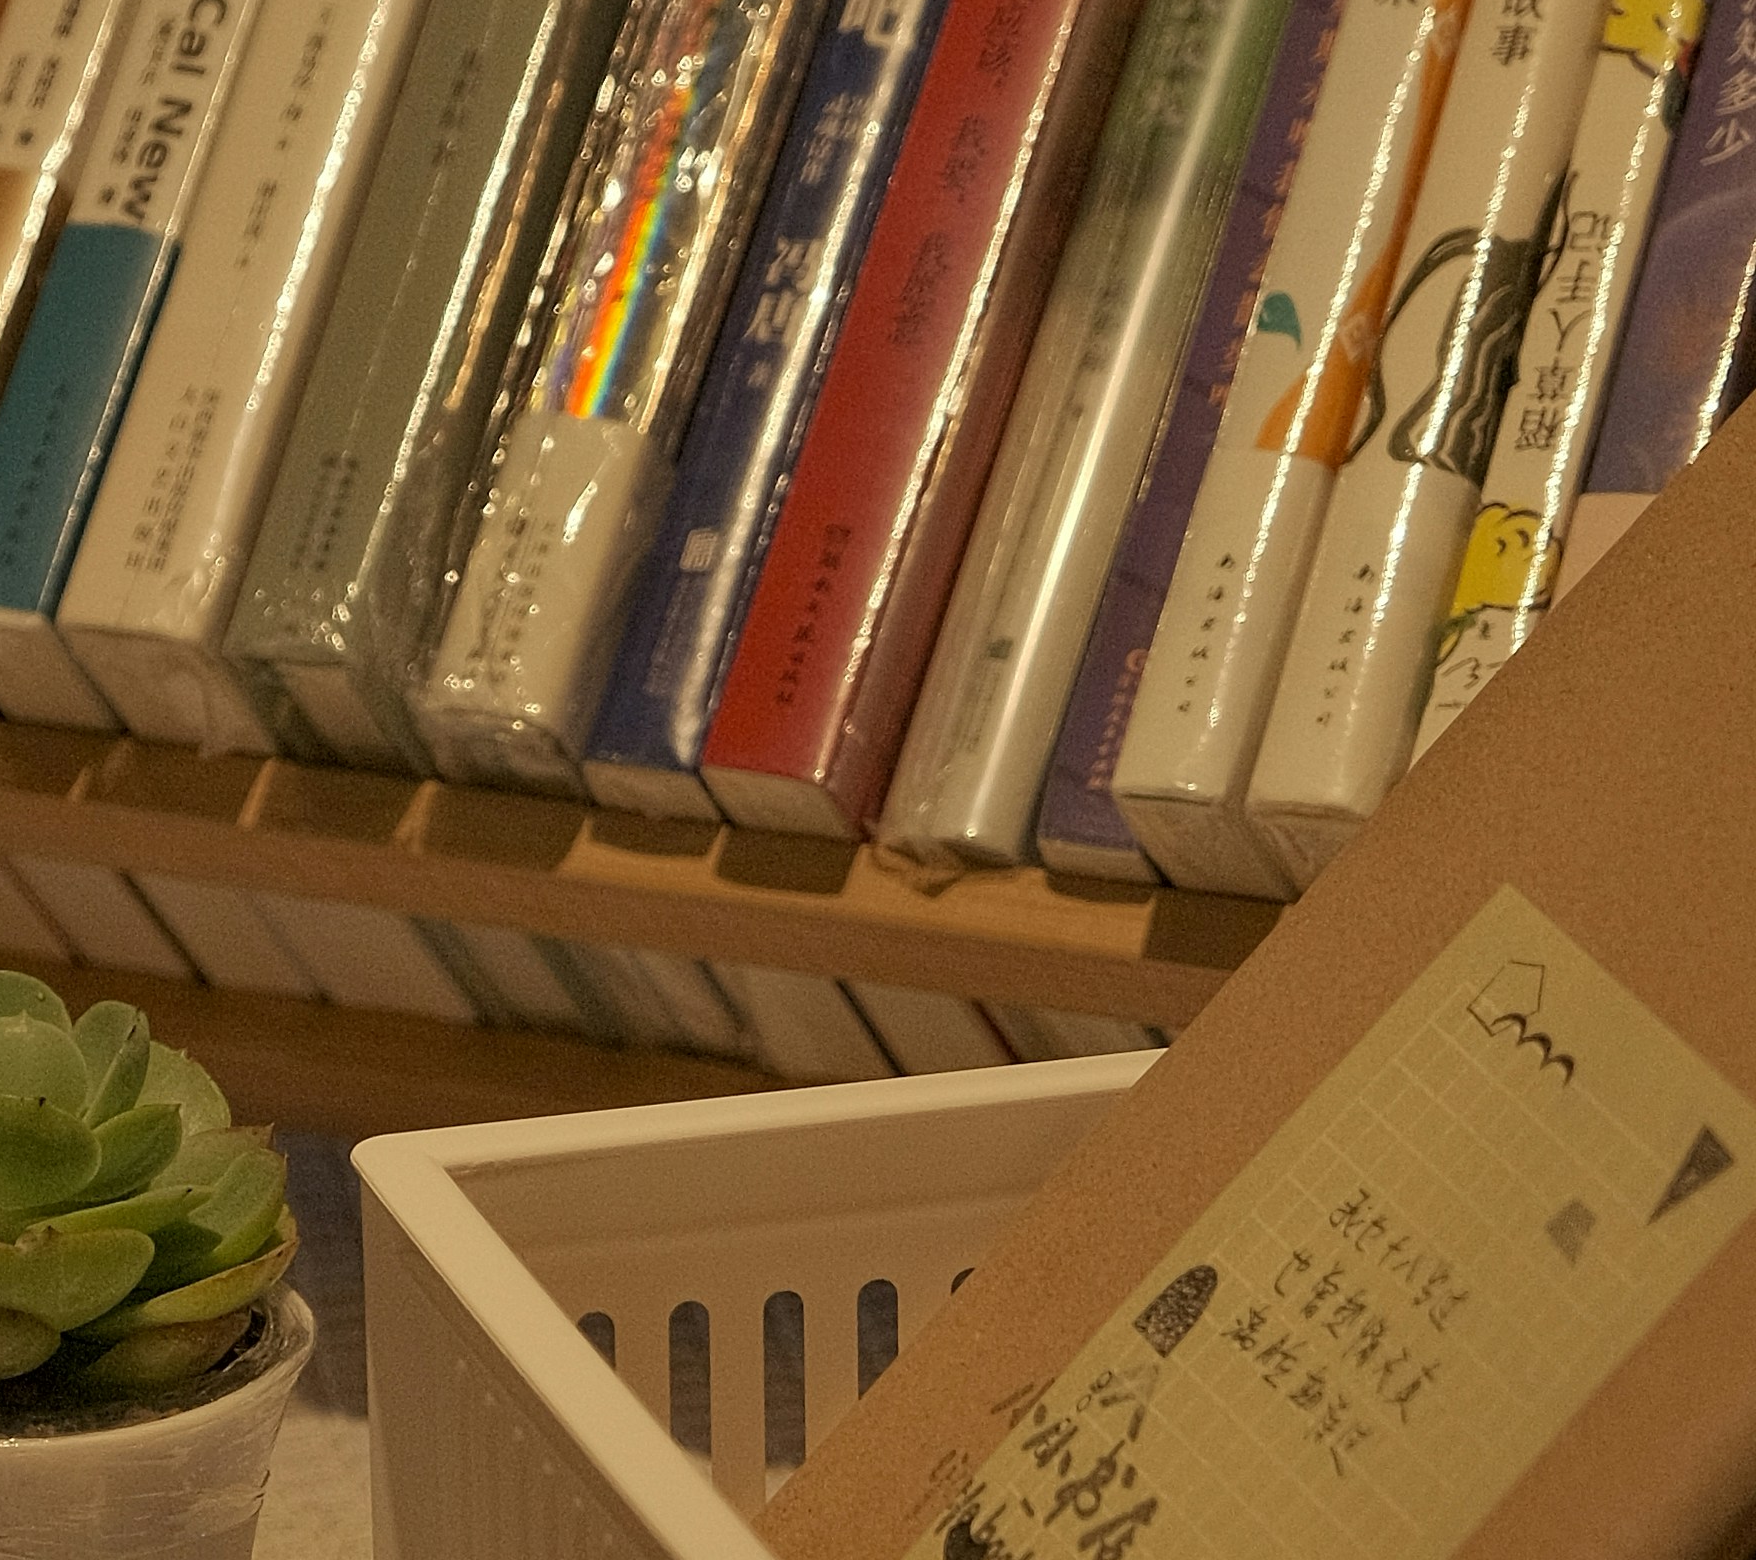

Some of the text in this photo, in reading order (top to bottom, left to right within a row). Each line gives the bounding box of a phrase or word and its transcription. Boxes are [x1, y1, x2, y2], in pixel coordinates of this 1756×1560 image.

[1515, 211, 1616, 450] 稻草人手记
